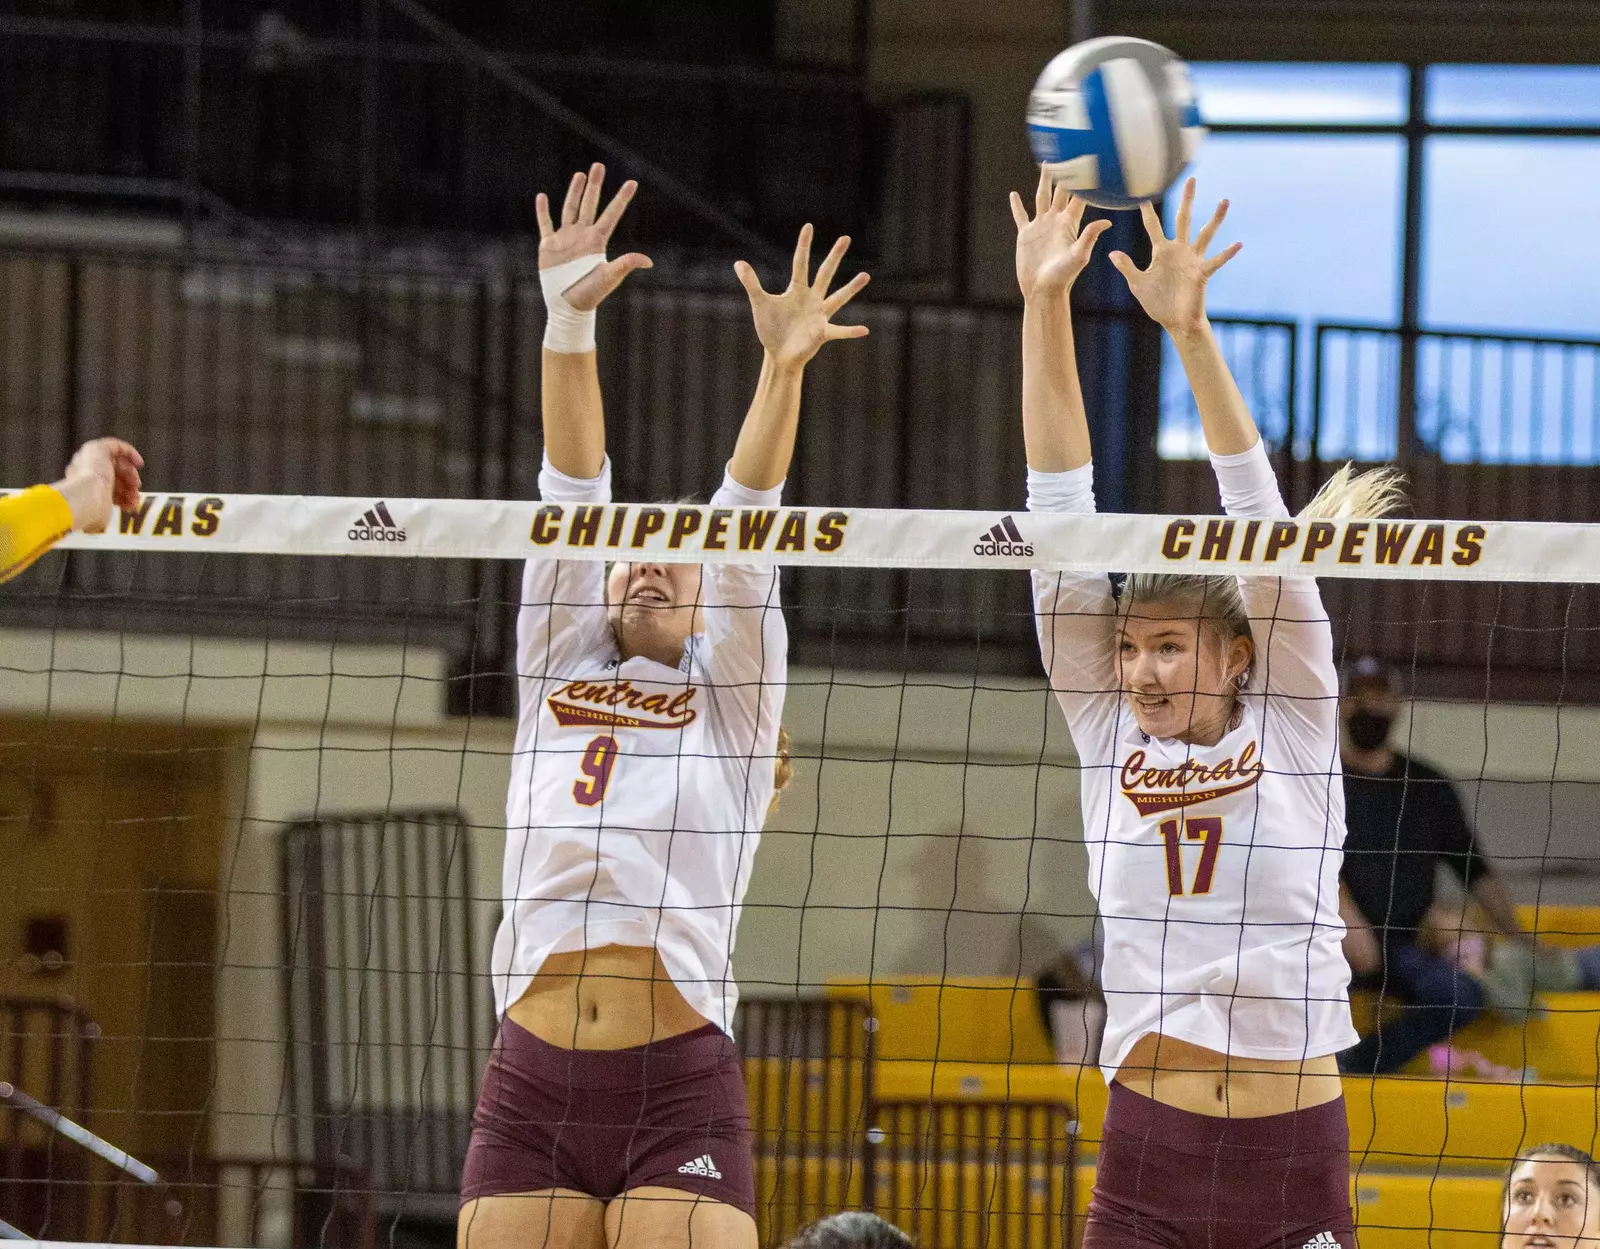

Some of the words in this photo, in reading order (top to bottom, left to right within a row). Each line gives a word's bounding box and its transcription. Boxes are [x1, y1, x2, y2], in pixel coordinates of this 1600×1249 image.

[82, 496, 225, 537] WAS
[348, 526, 407, 541] adidas
[530, 504, 849, 552] CHIPPEWAS
[973, 540, 1035, 557] adidas
[1161, 518, 1487, 568] CHIPPEWAS
[549, 680, 697, 719] entral
[556, 705, 640, 727] MICHIGAN
[572, 734, 621, 808] 9
[1120, 740, 1265, 791] Central
[1136, 791, 1217, 804] MICHIGAN
[1160, 816, 1224, 896] 17
